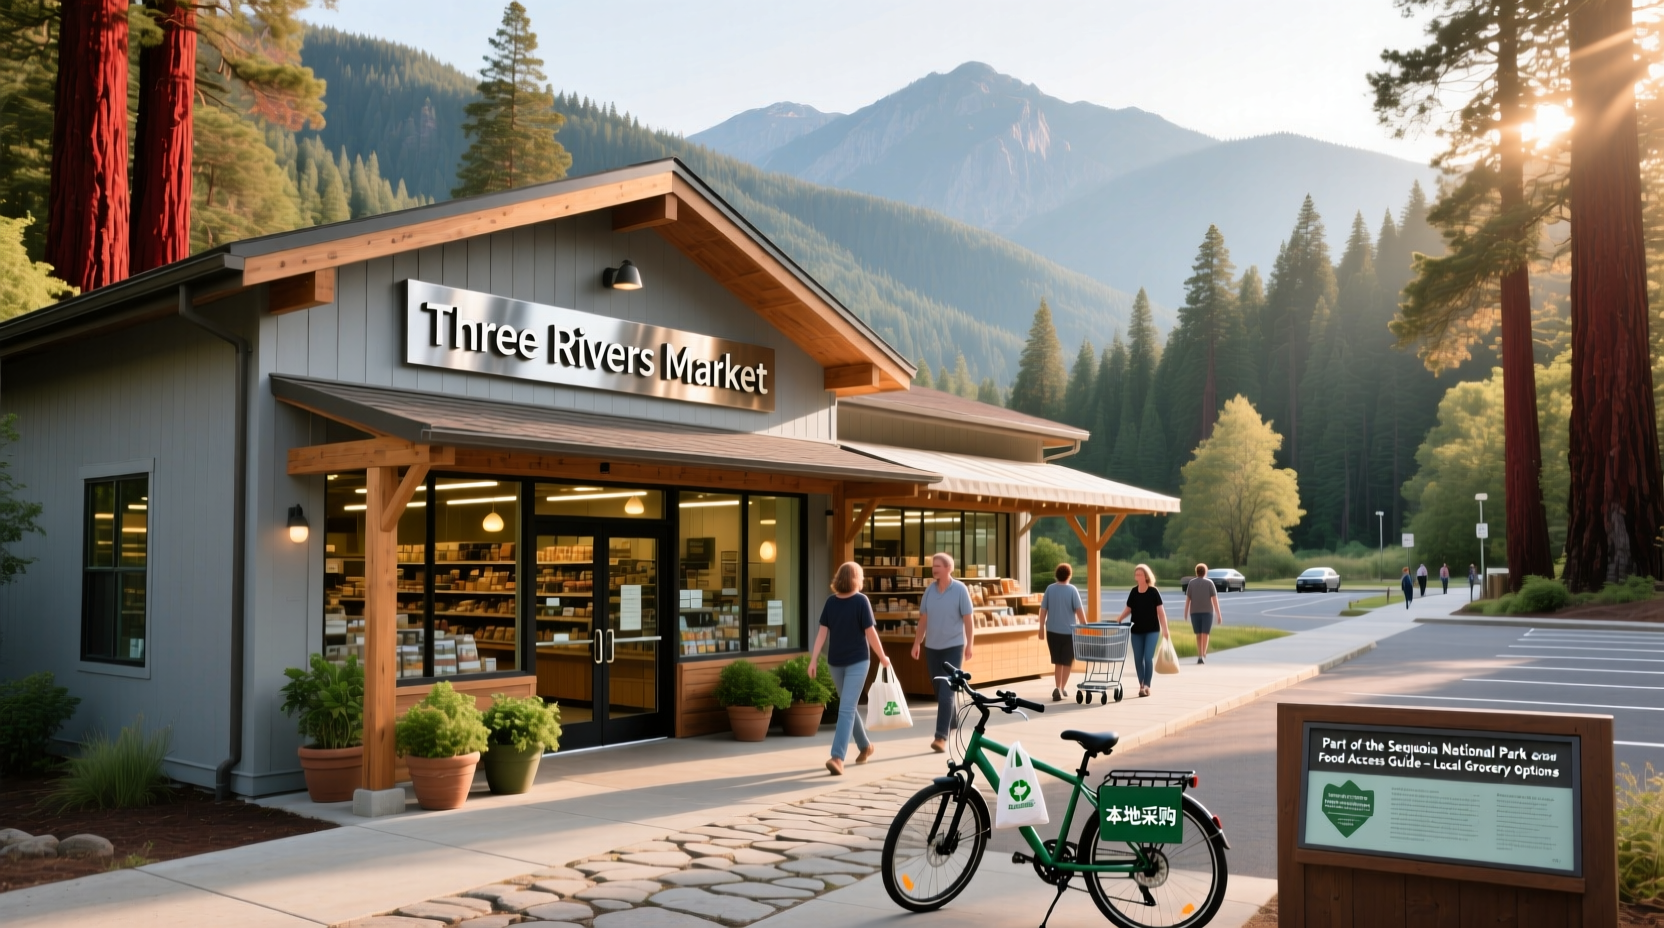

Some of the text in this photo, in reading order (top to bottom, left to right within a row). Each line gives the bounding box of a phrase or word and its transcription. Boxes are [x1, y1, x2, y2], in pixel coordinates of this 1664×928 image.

[424, 301, 768, 395] Three Rivers Market
[1322, 737, 1347, 750] Part
[1350, 738, 1363, 751] of
[1365, 738, 1385, 752] the
[1442, 742, 1495, 759] National
[1499, 746, 1527, 761] Park
[1318, 752, 1345, 764] Food
[1433, 758, 1461, 771] Local
[1464, 760, 1511, 778] Grocery
[1514, 764, 1560, 780] Options
[1105, 804, 1177, 827] 本地采购
